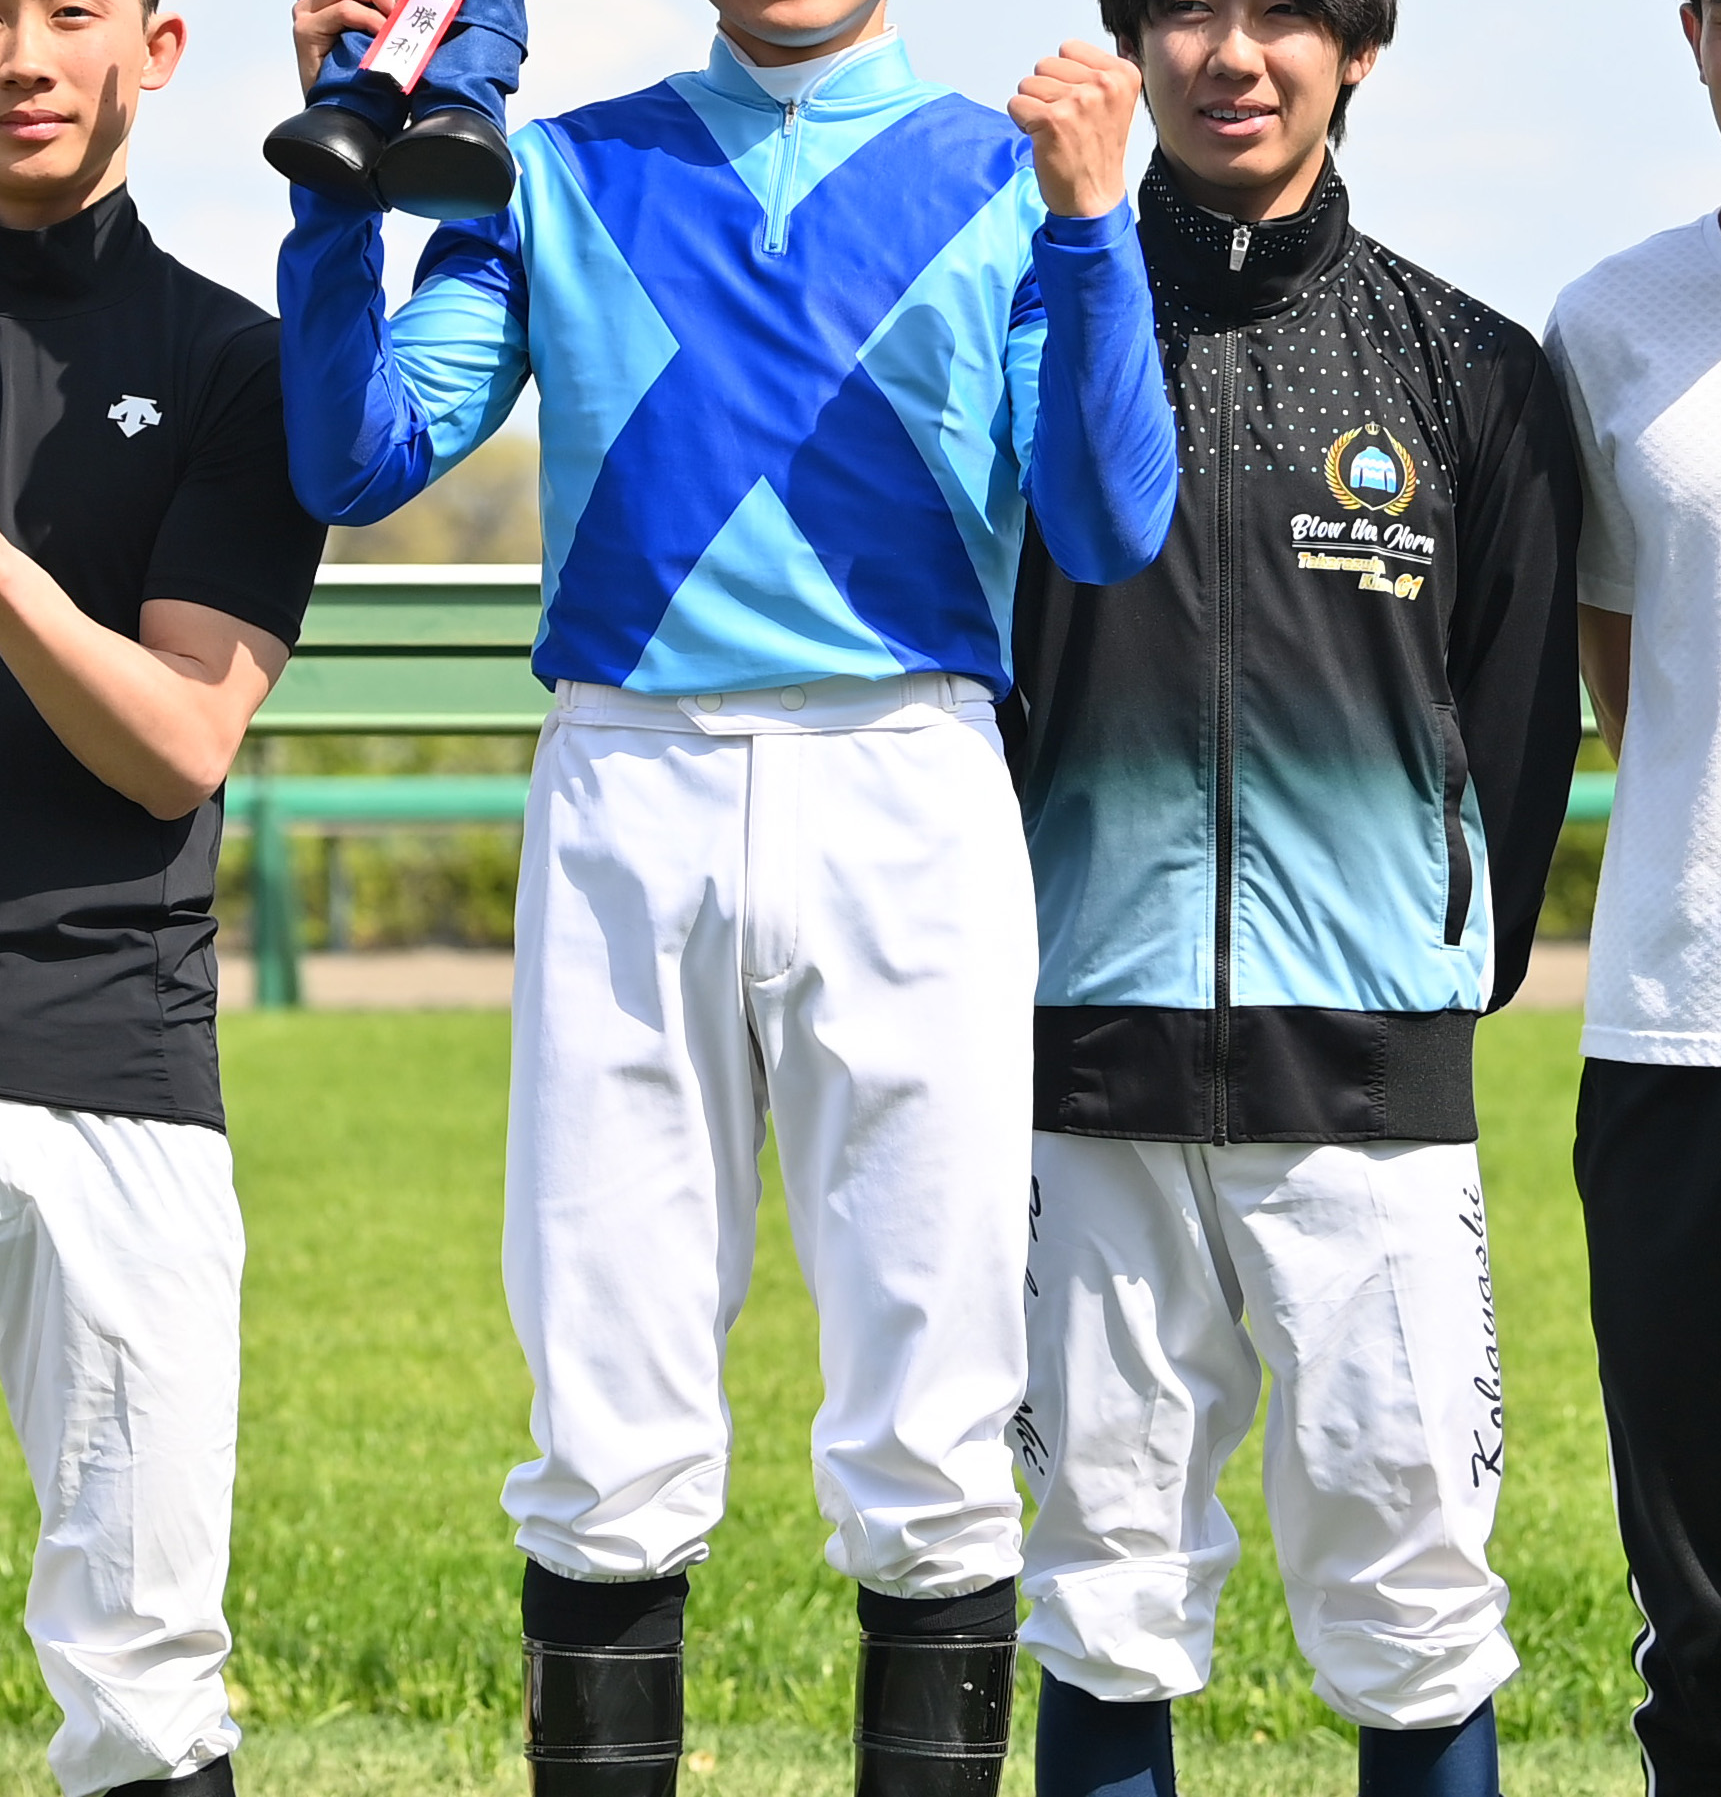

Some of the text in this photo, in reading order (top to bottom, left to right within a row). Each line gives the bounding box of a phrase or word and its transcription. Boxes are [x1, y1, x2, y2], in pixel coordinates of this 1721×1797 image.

[1290, 513, 1347, 541] Blow
[1383, 523, 1435, 555] Horn
[1394, 573, 1424, 601] G1
[1459, 1184, 1504, 1489] Kobayashi
